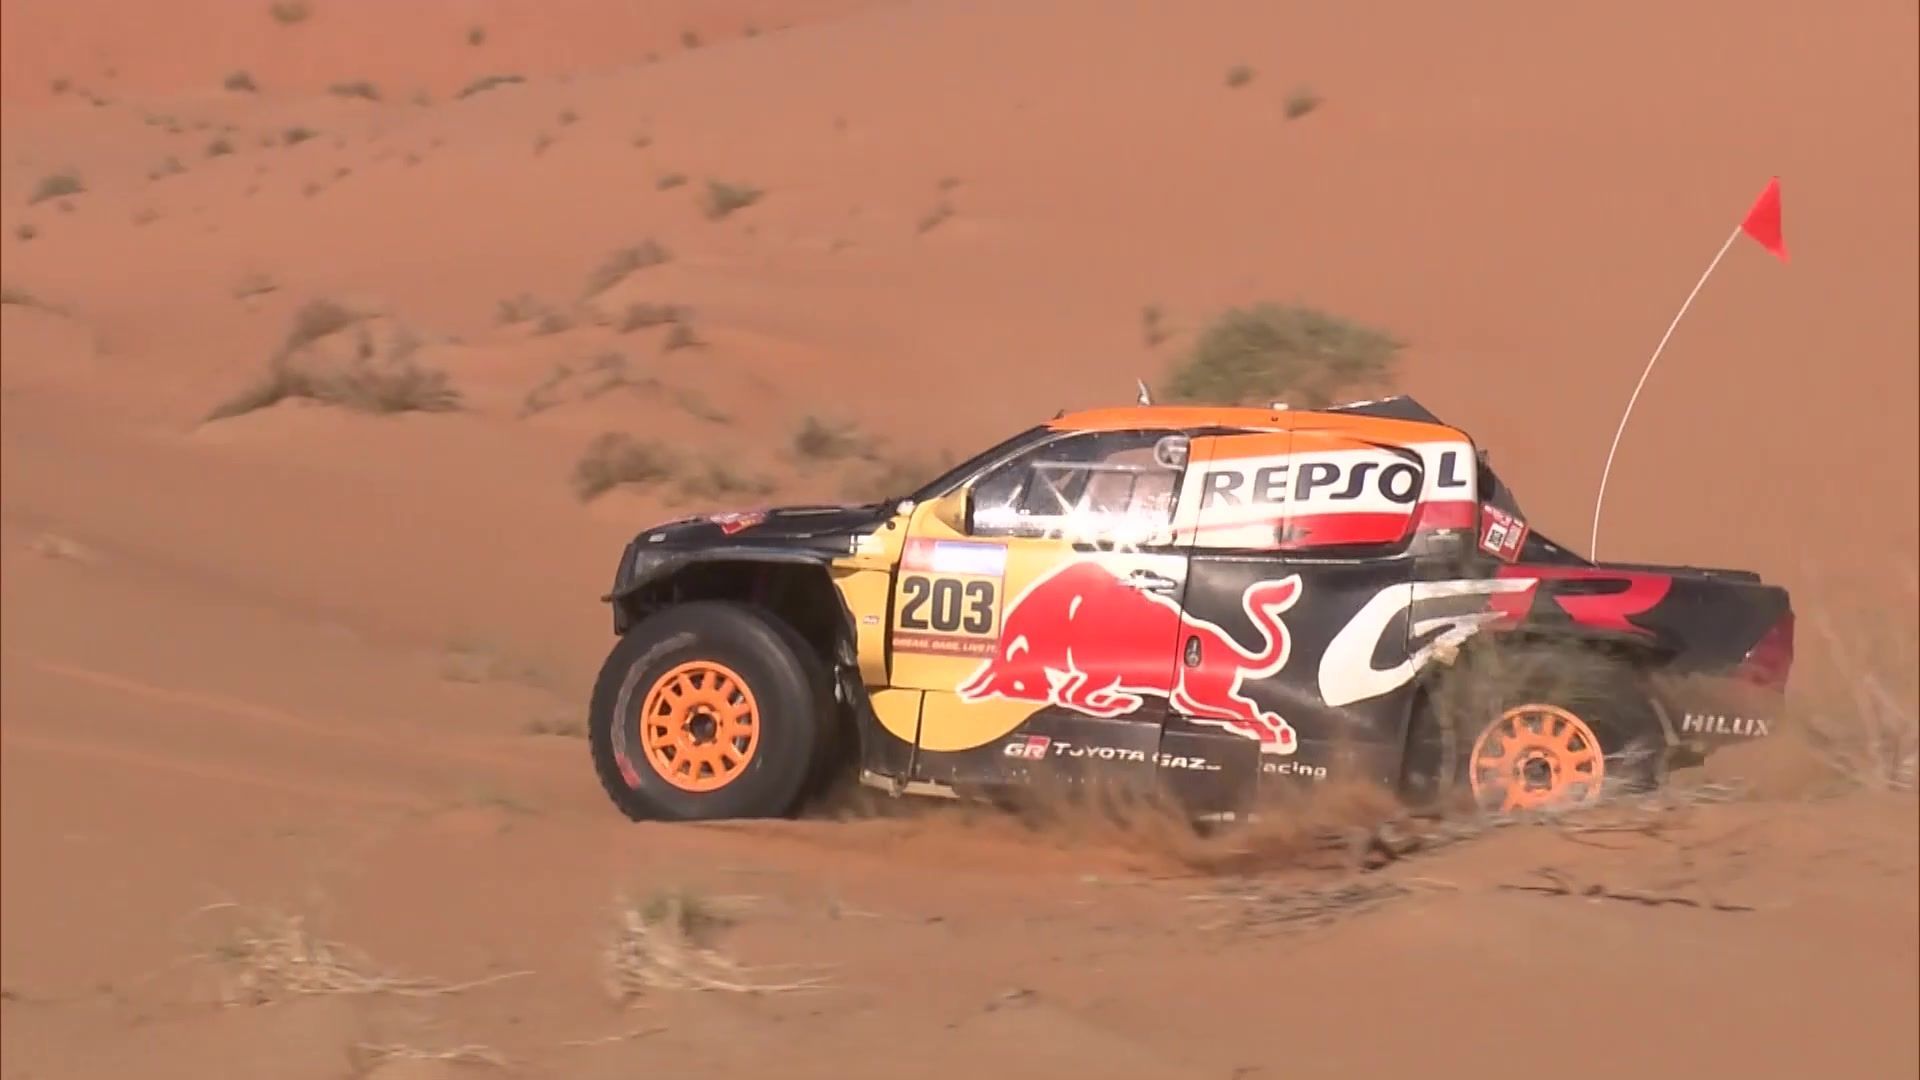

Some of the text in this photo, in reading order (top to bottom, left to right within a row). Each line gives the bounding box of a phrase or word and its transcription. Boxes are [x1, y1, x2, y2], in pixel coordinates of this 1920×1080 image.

[1201, 451, 1467, 509] REPSOL
[900, 575, 995, 634] 203
[1682, 714, 1770, 737] HILUX
[1003, 739, 1049, 761] GR
